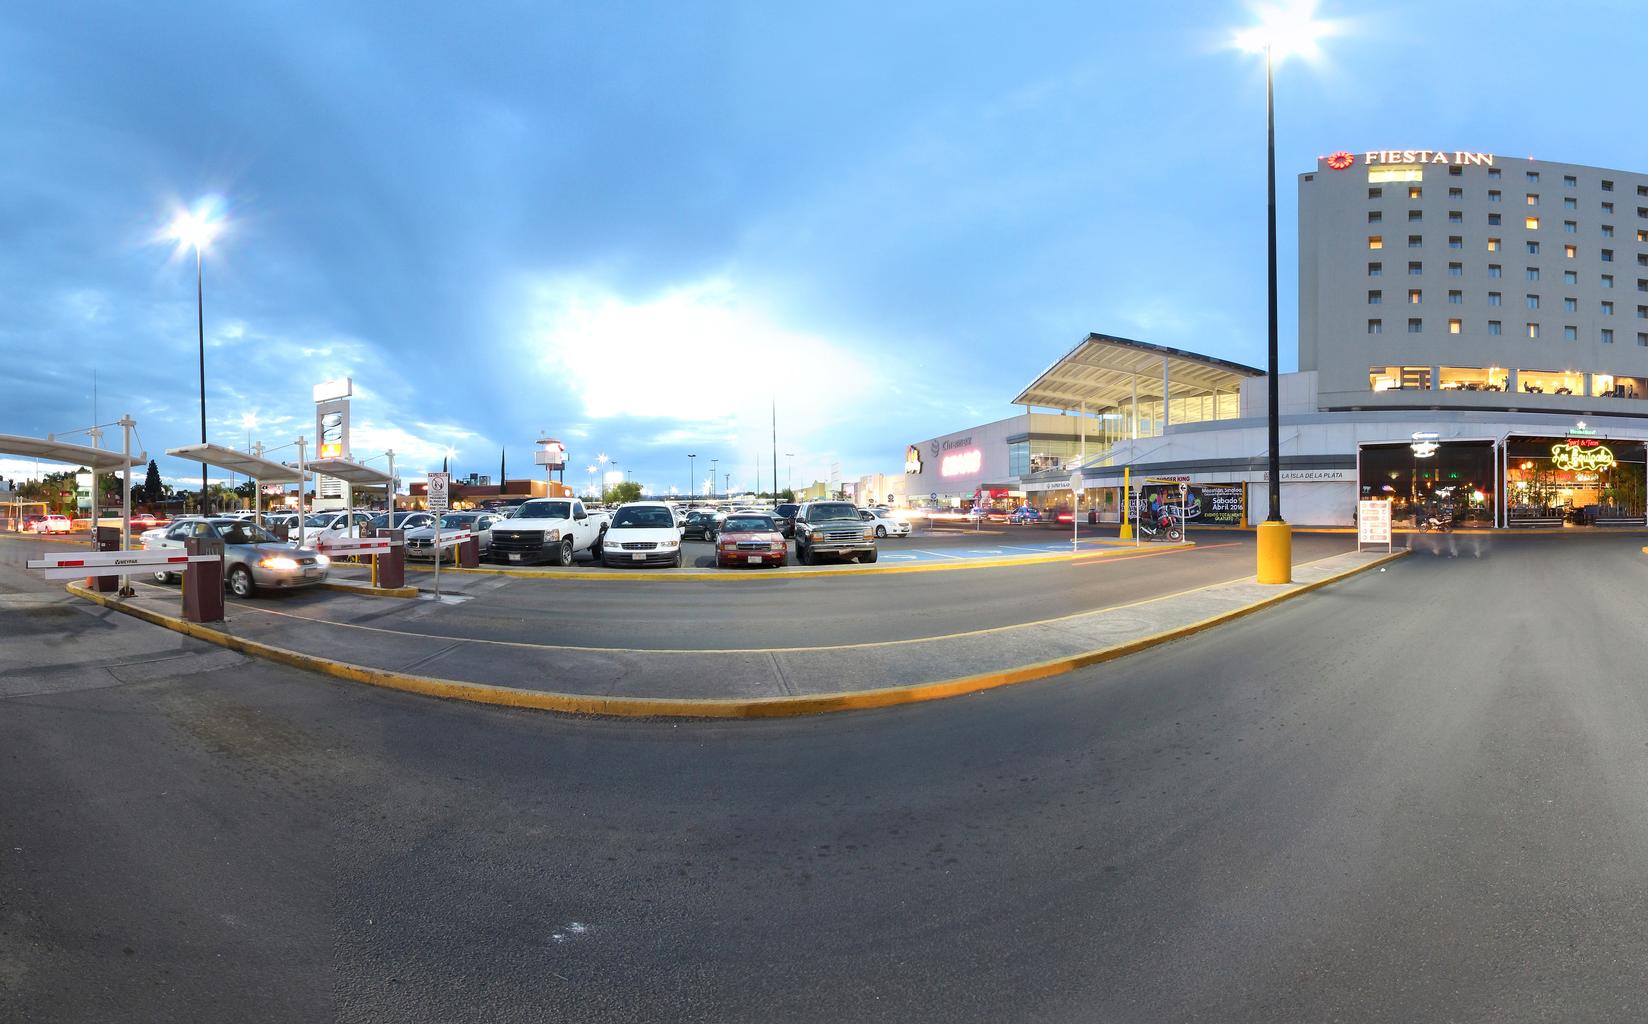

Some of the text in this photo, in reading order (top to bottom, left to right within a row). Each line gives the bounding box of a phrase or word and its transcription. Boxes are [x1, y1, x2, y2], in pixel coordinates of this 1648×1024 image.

[1365, 150, 1493, 166] FIESTA INN
[1552, 447, 1569, 463] Los
